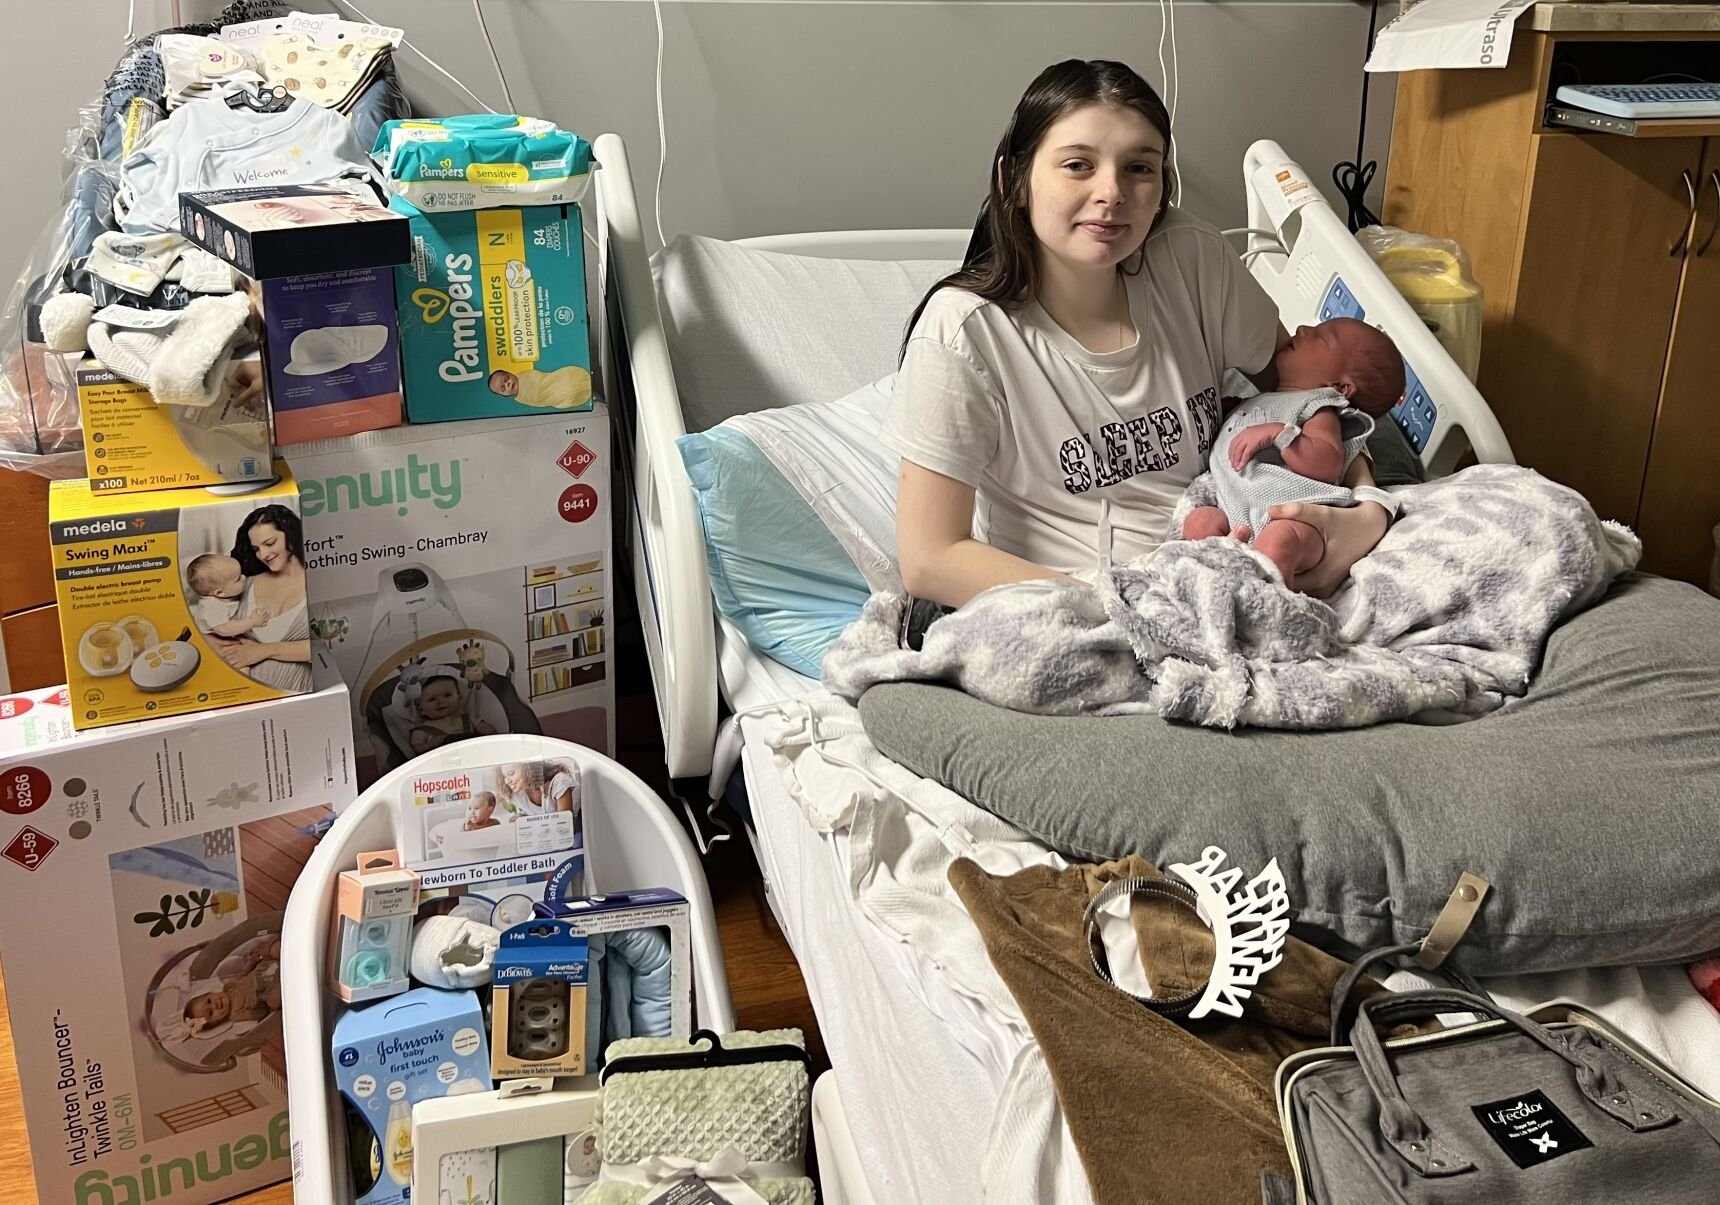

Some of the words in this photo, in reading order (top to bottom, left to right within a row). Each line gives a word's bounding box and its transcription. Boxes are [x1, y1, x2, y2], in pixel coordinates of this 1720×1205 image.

[232, 168, 289, 184] Welcome
[419, 164, 464, 179] Pampers
[476, 170, 518, 178] sensitive
[446, 193, 458, 201] NOT
[459, 192, 476, 200] FLUSH
[488, 232, 506, 247] N
[533, 228, 546, 246] 84
[545, 225, 554, 248] DIAPERS
[552, 222, 561, 251] COUCHES
[415, 237, 426, 280] PEDIATRICIAN
[290, 283, 304, 291] keep
[488, 275, 507, 357] swaddlers
[512, 291, 520, 323] LEAKPROOF
[522, 290, 534, 337] protection
[538, 309, 544, 317] de
[438, 253, 483, 383] Pampers
[539, 318, 547, 348] protection
[524, 339, 534, 357] skin
[565, 426, 586, 435] 16927
[1059, 386, 1218, 495] SLEEPY
[563, 453, 590, 466] U-90
[99, 479, 123, 489] x100
[130, 477, 148, 486] Net
[149, 474, 177, 485] 210ml
[184, 472, 201, 481] 7oz
[300, 453, 462, 517] enuity
[563, 498, 590, 512] 9441
[63, 519, 127, 537] medela
[66, 548, 109, 561] Swing
[304, 552, 358, 570] othing
[361, 544, 406, 561] Swing
[416, 530, 488, 552] Chambray
[68, 566, 111, 577] Hands-free
[117, 560, 163, 571] Mains-libres
[70, 584, 95, 593] Double
[96, 582, 119, 590] electric
[142, 578, 162, 586] pump
[14, 774, 33, 808] 8266
[414, 774, 470, 795] Hopscotch
[22, 832, 39, 865] U-59
[469, 868, 483, 879] To
[485, 861, 528, 877] Toddler
[531, 857, 556, 870] Bath
[553, 862, 573, 883] Foam
[377, 1029, 446, 1066] Johnson's
[402, 1048, 425, 1059] baby
[390, 1062, 409, 1074] first
[411, 1054, 440, 1068] touch
[403, 1070, 416, 1081] gift
[417, 1068, 429, 1076] set
[112, 1092, 138, 1151] 0M-6M
[1488, 1101, 1543, 1126] Lifecolor
[63, 1091, 89, 1167] InLighten
[88, 1100, 113, 1160] Twinkle
